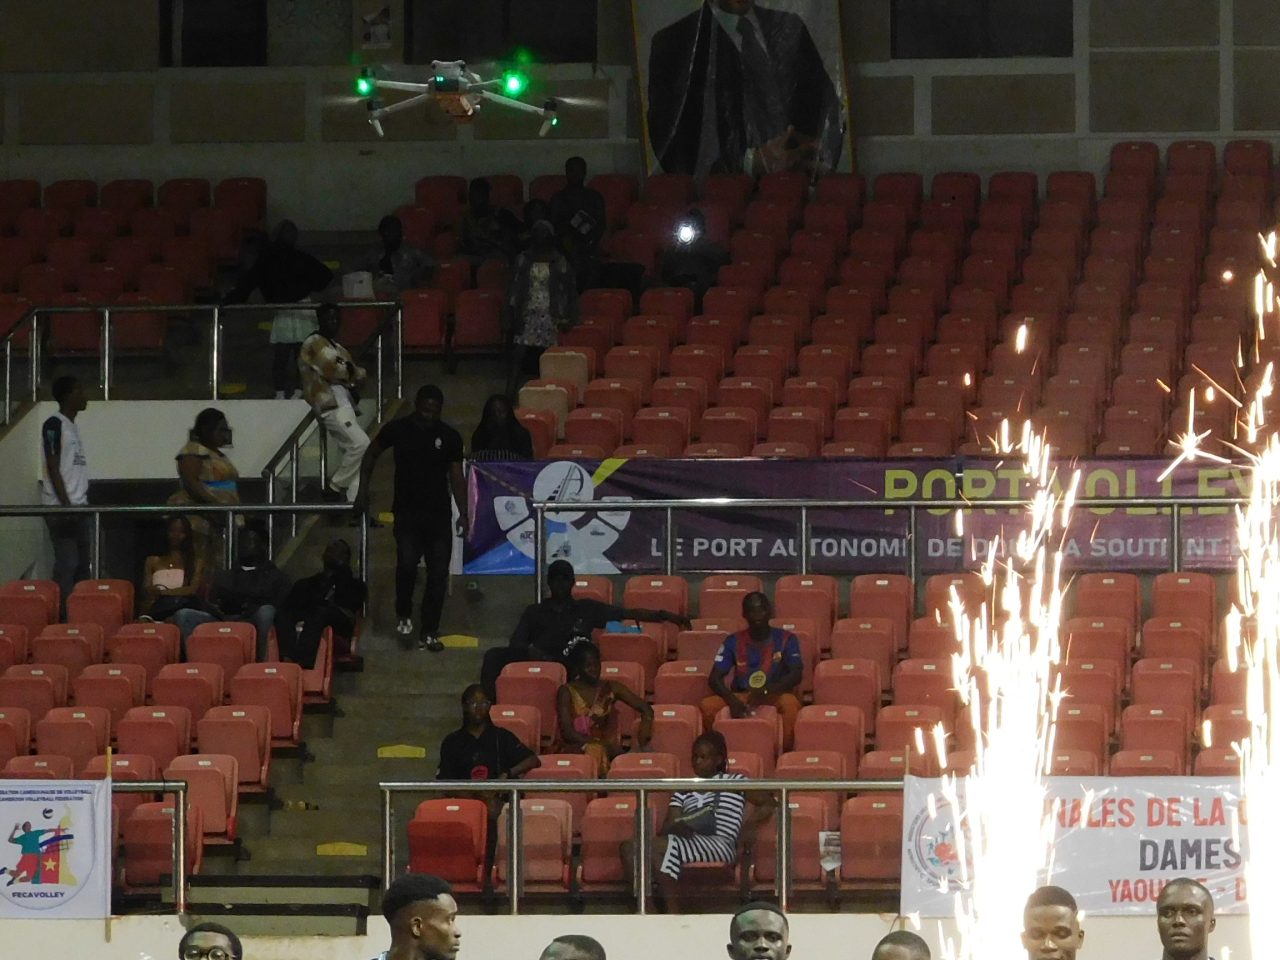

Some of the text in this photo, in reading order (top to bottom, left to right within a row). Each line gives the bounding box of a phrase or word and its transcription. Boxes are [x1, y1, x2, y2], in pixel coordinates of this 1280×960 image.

[693, 539, 763, 557] PORT
[928, 539, 961, 557] DE
[1147, 797, 1181, 827] DE
[1193, 797, 1225, 827] LA
[1140, 838, 1242, 871] DAMES
